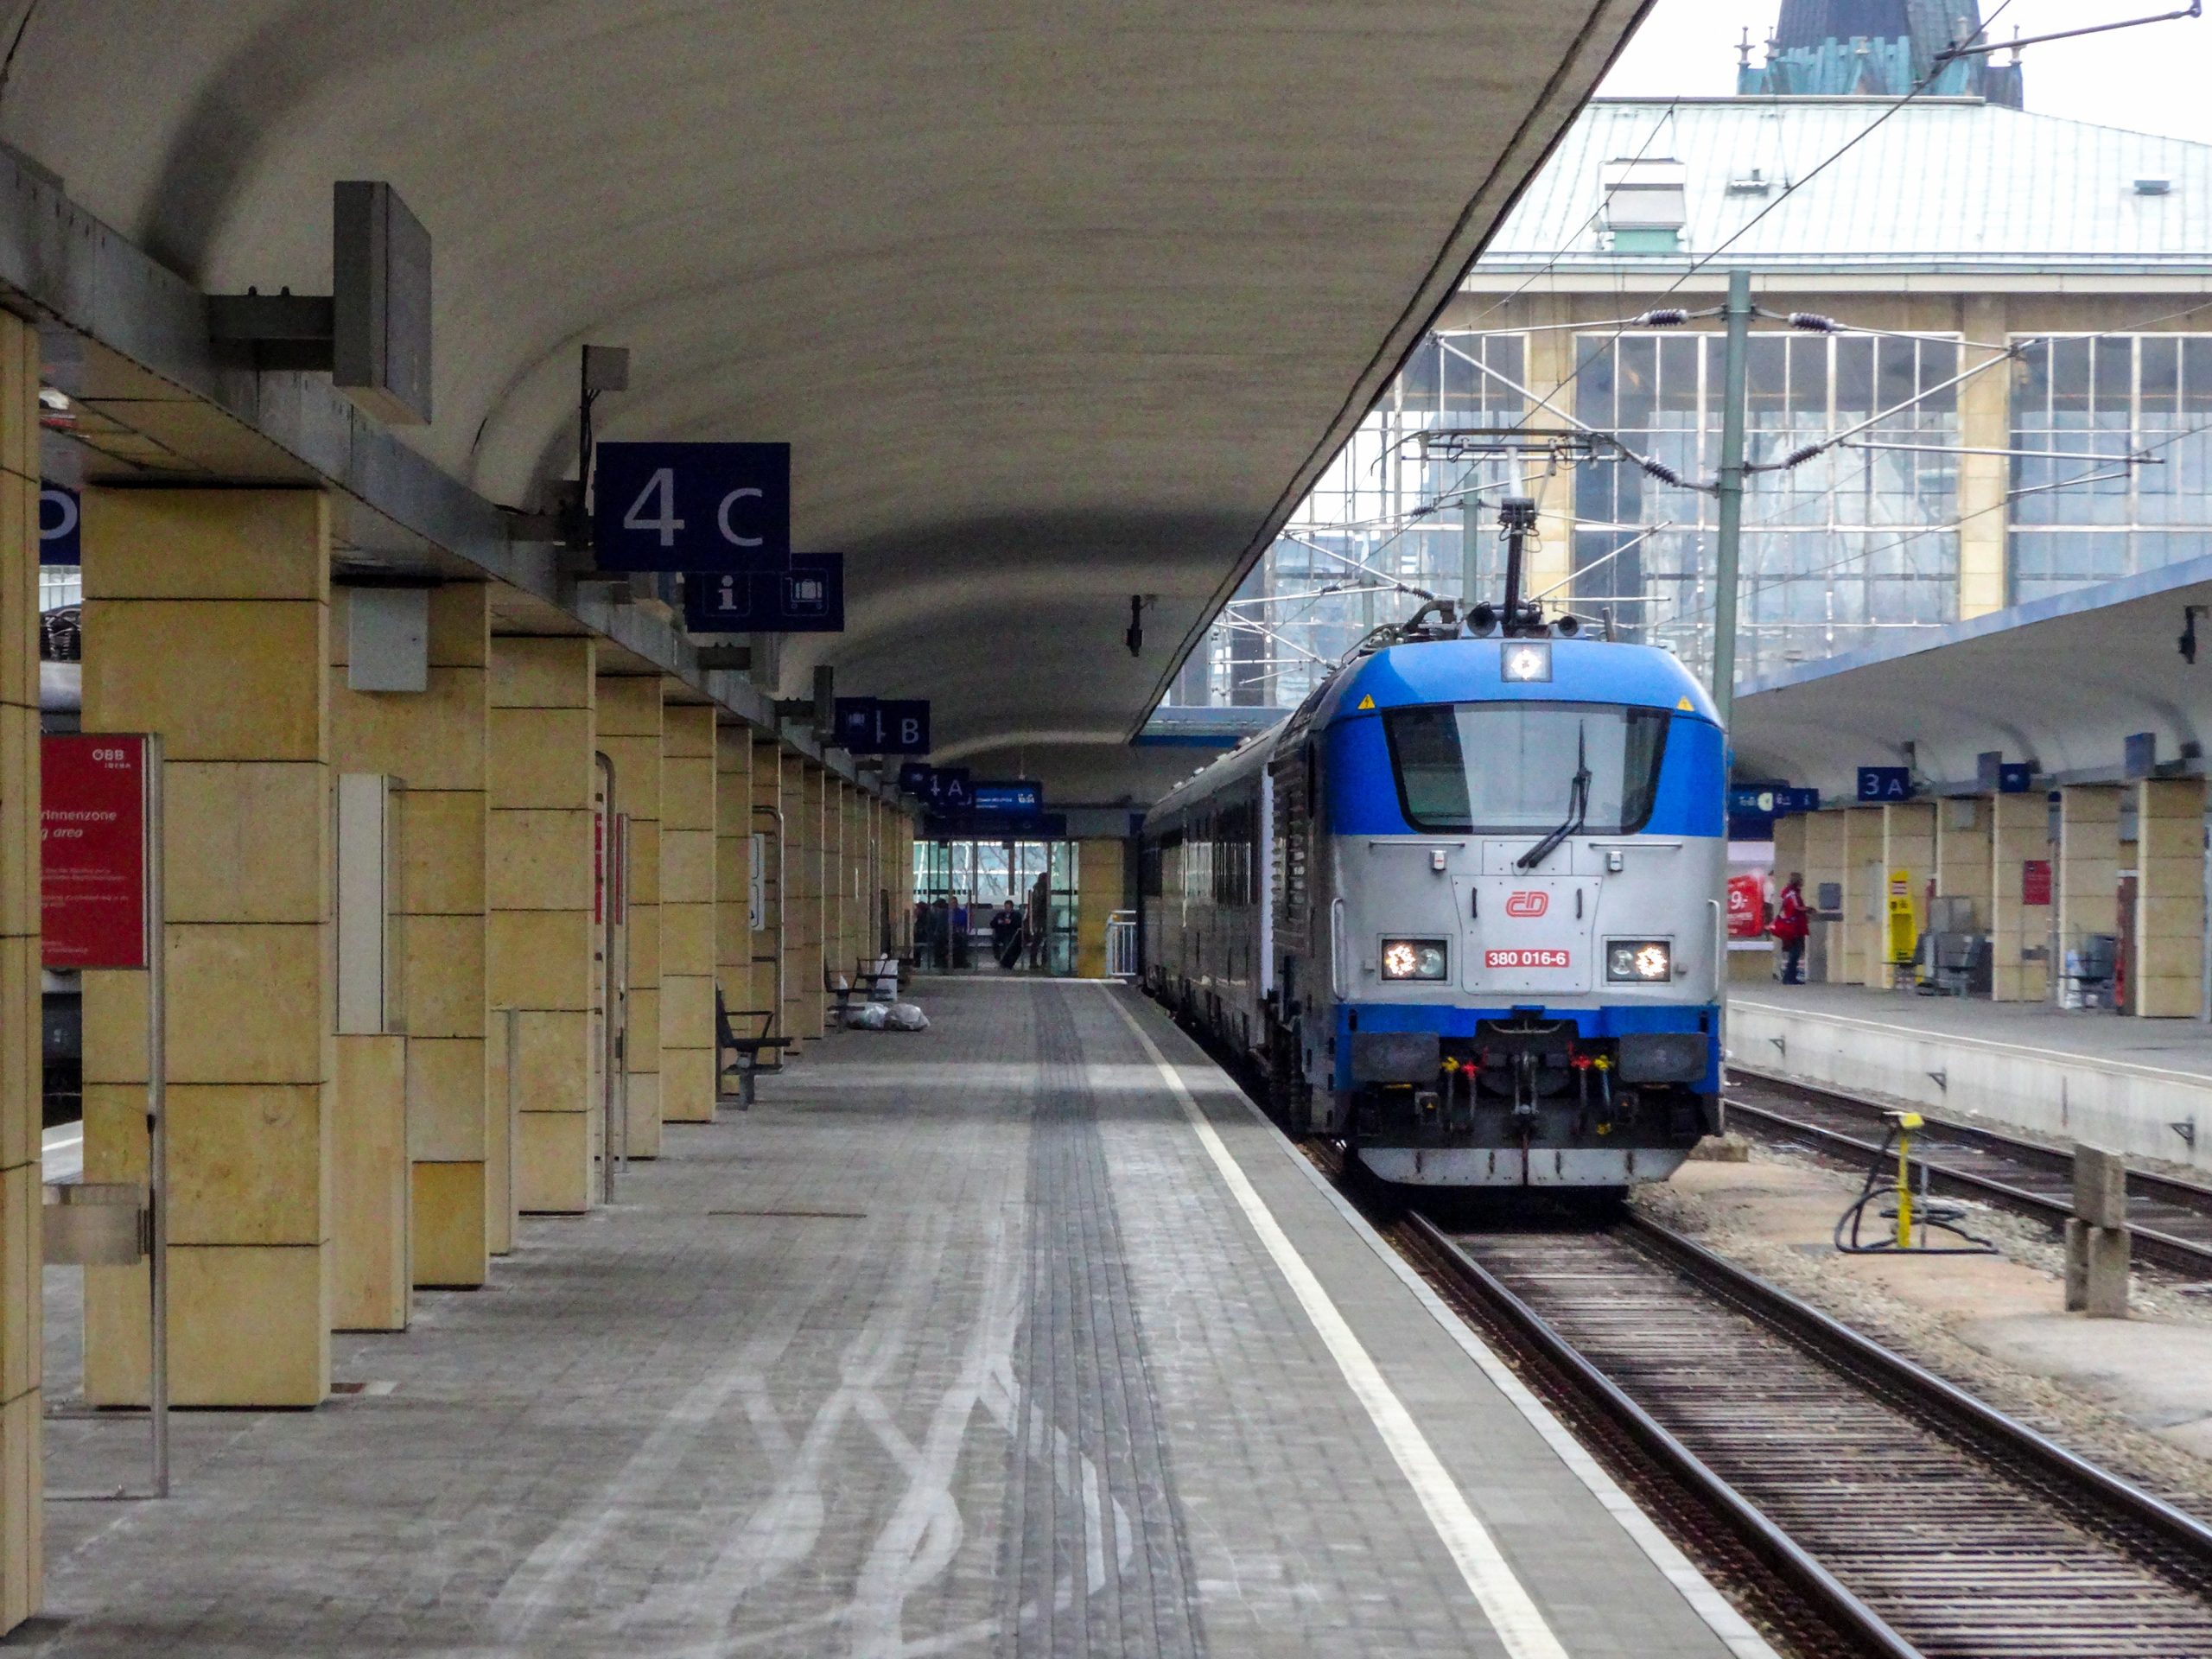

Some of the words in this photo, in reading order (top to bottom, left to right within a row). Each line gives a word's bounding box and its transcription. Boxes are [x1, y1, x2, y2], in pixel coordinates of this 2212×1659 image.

[623, 467, 685, 547] 4
[717, 487, 763, 547] C
[901, 718, 919, 744] B
[948, 779, 963, 797] A
[1865, 773, 1879, 795] 3
[1887, 779, 1903, 795] A
[1489, 951, 1518, 965] 380
[1522, 951, 1567, 965] 016-6
